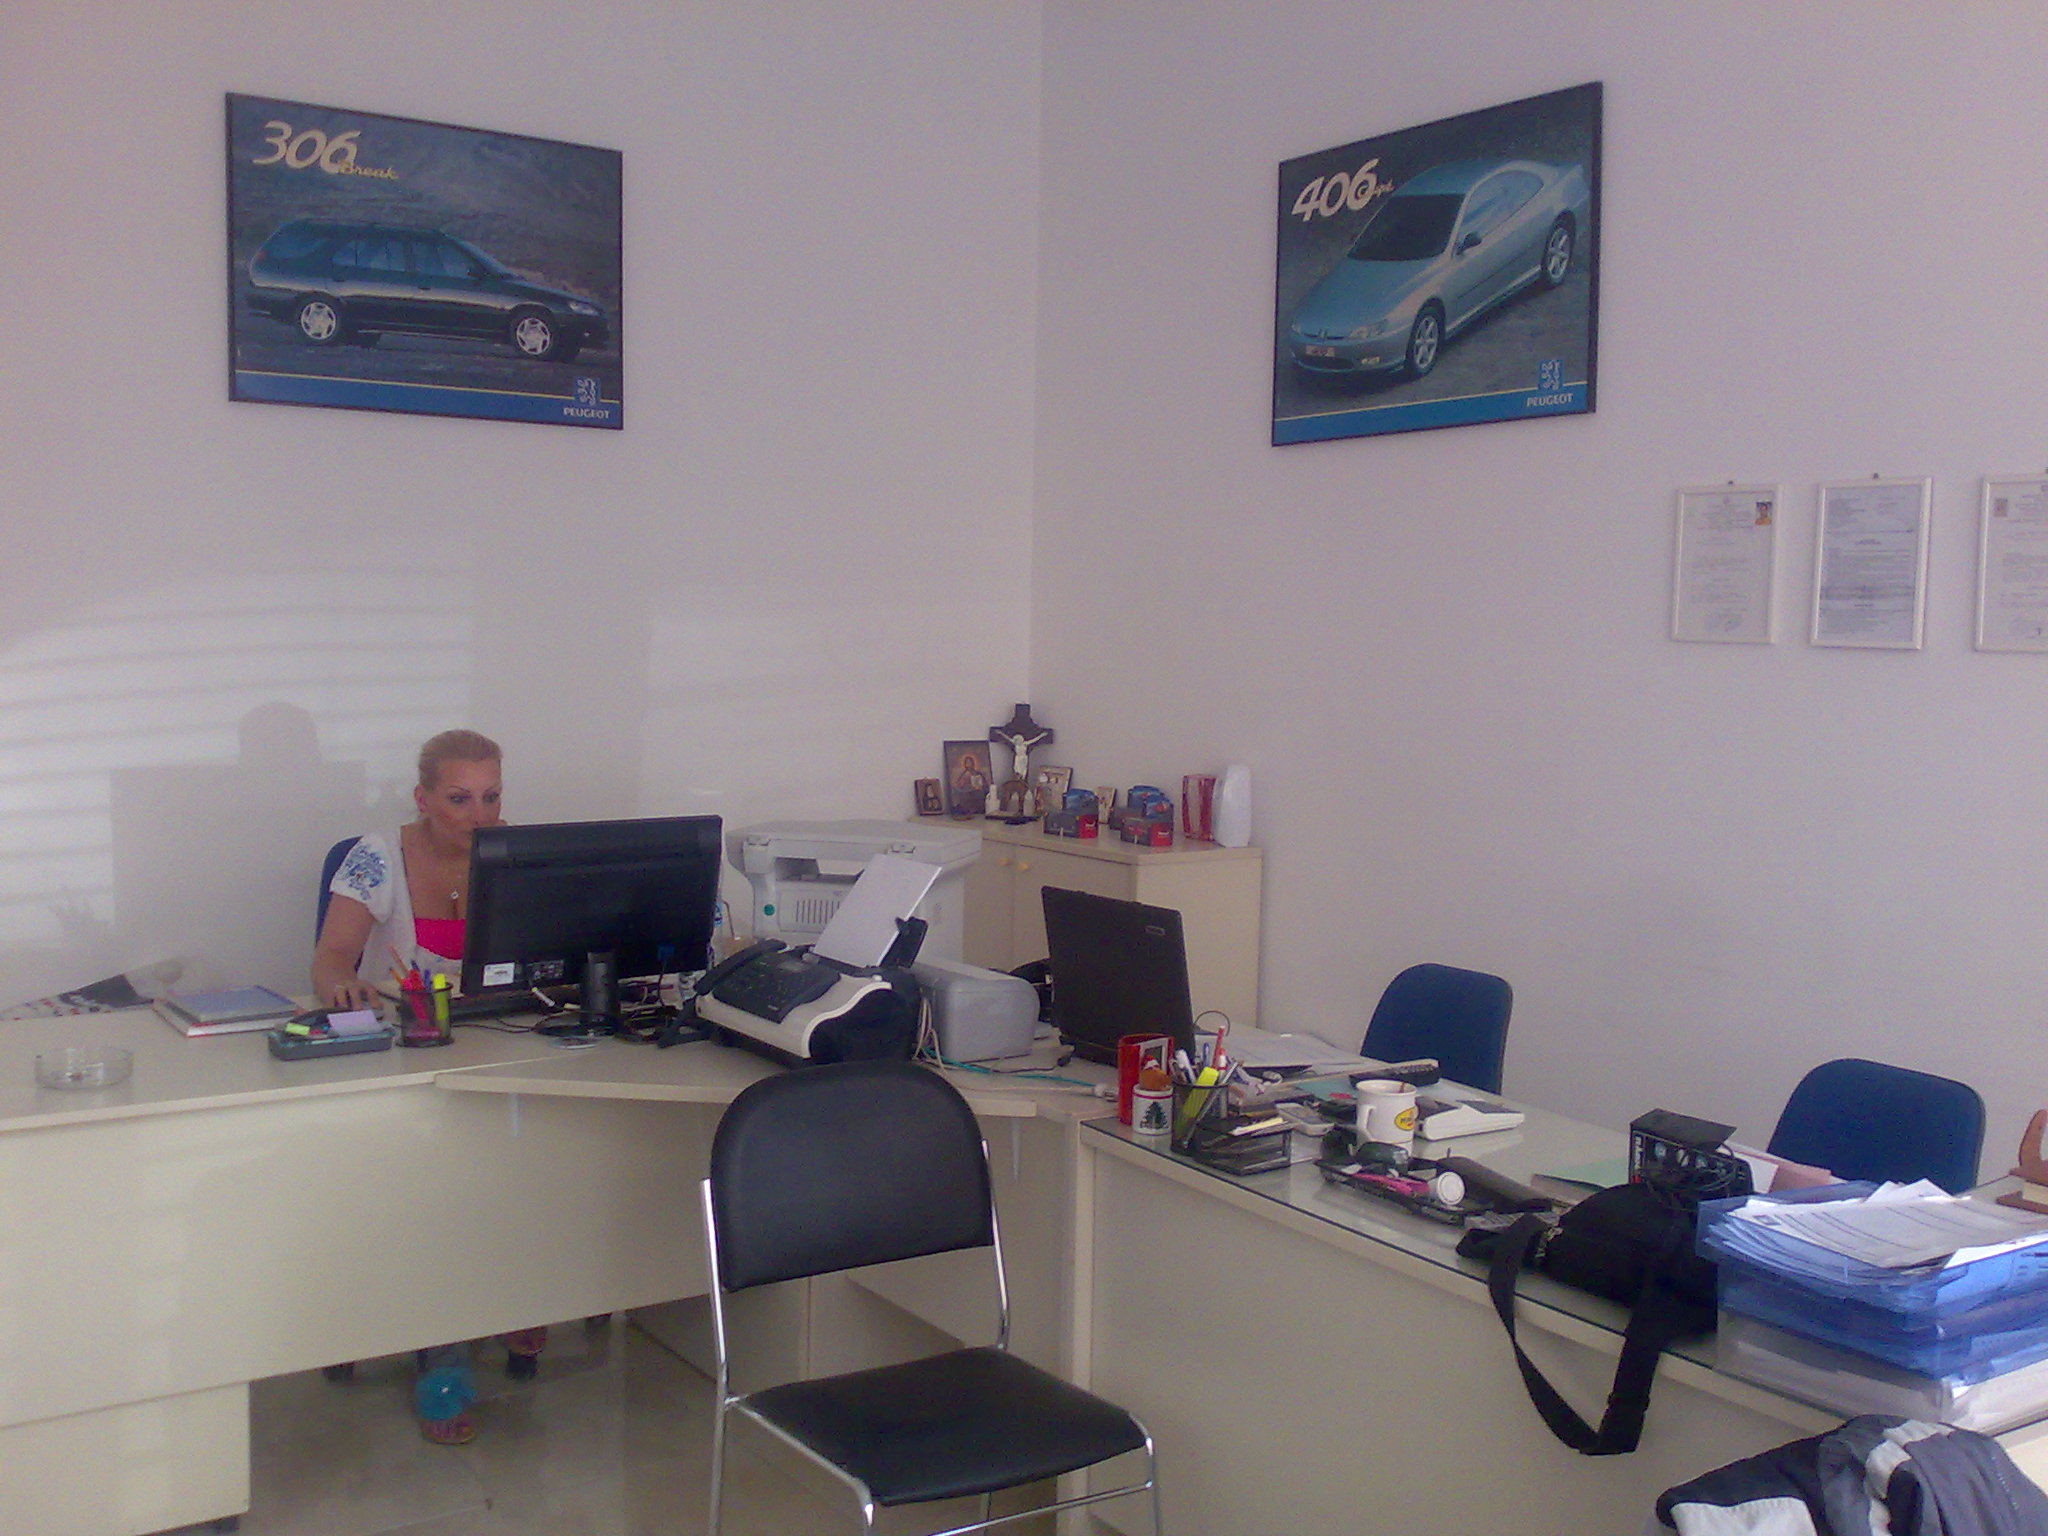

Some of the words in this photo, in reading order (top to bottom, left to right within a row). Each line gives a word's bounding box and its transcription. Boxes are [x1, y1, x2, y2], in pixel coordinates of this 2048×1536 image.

[252, 119, 361, 174] 306
[1291, 158, 1380, 222] 406
[563, 407, 610, 419] PEUGEOT
[1526, 392, 1574, 407] PEUGEOT
